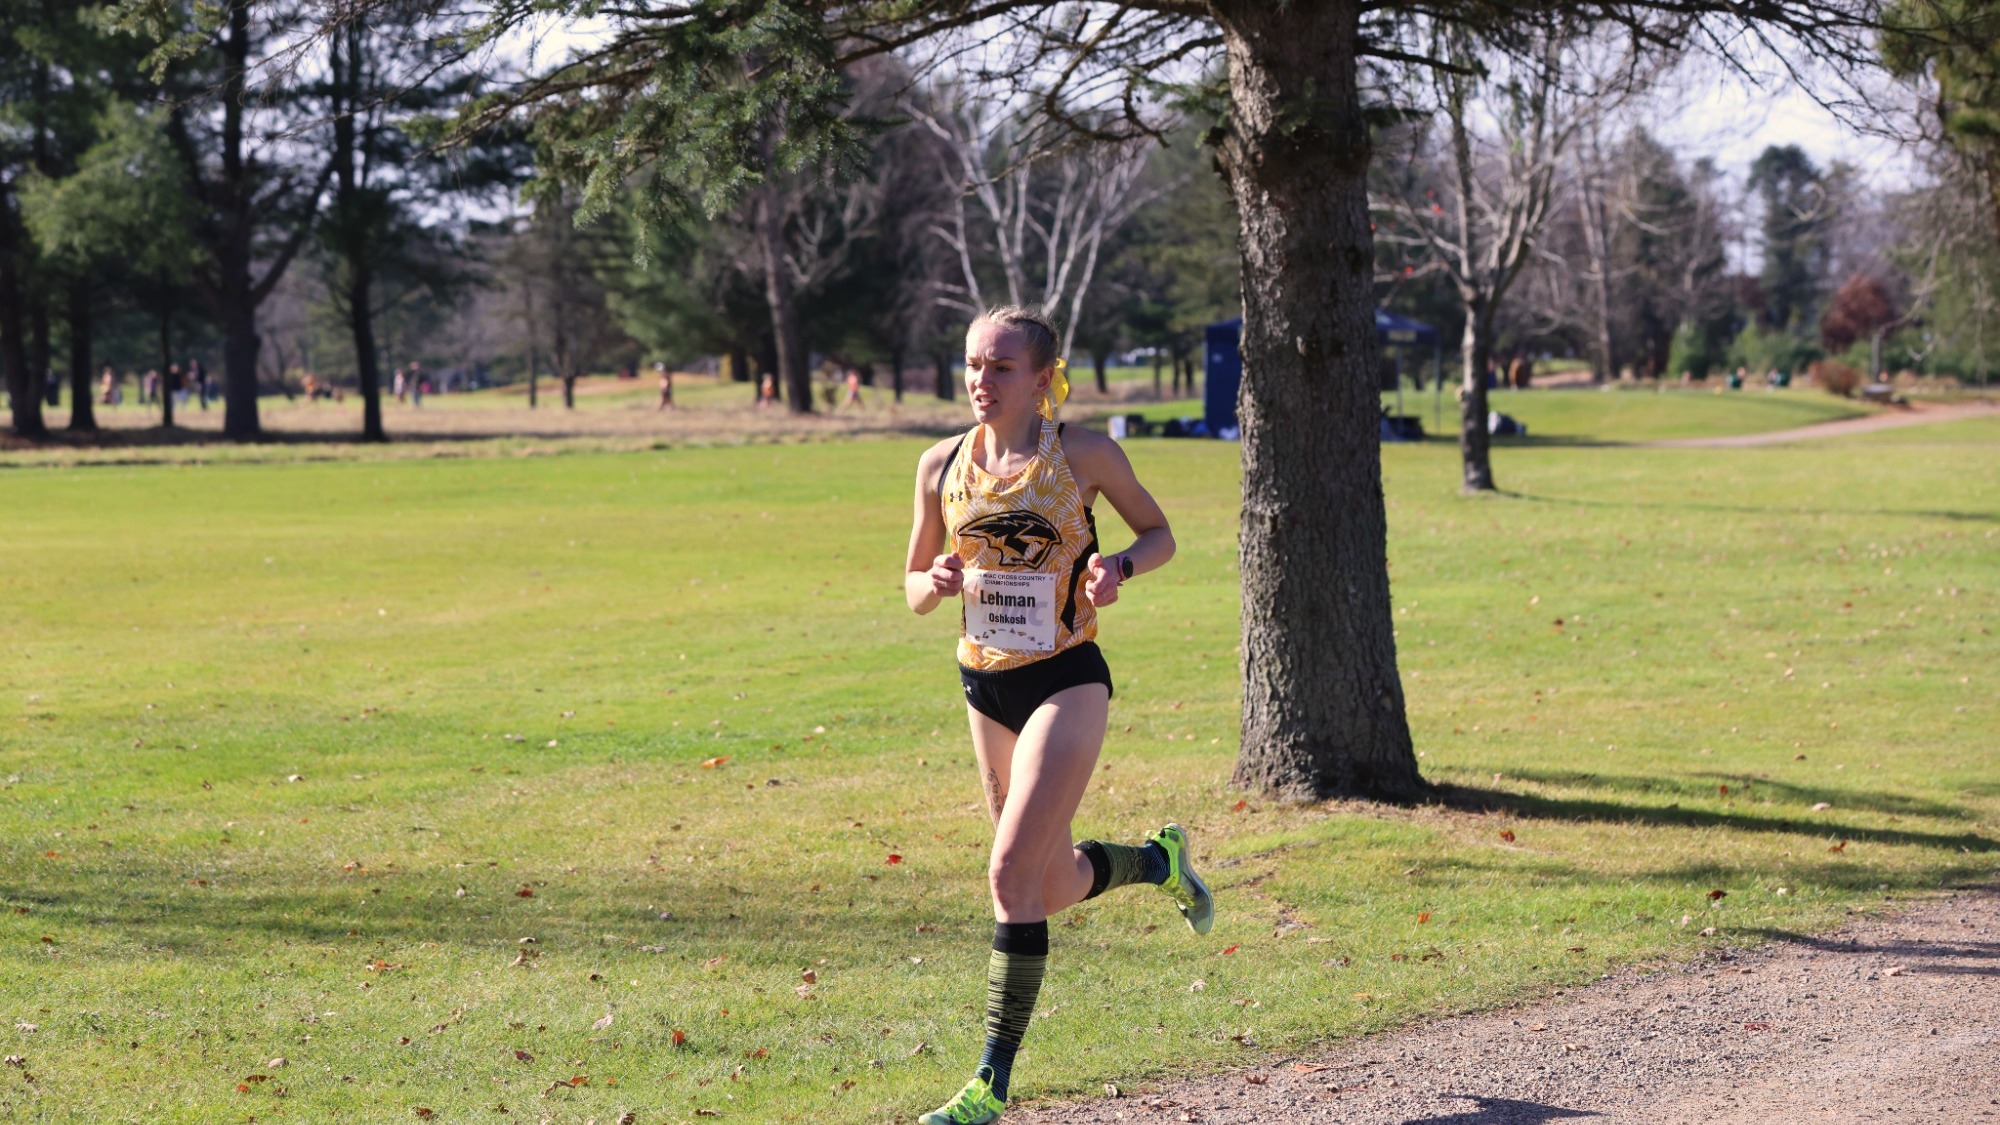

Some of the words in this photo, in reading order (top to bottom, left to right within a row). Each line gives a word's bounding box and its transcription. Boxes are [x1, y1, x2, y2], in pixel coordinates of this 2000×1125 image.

[984, 579, 1030, 587] CHAMPIONSHIPS
[980, 589, 1036, 608] Lehman
[988, 612, 1026, 625] Oshkosh
